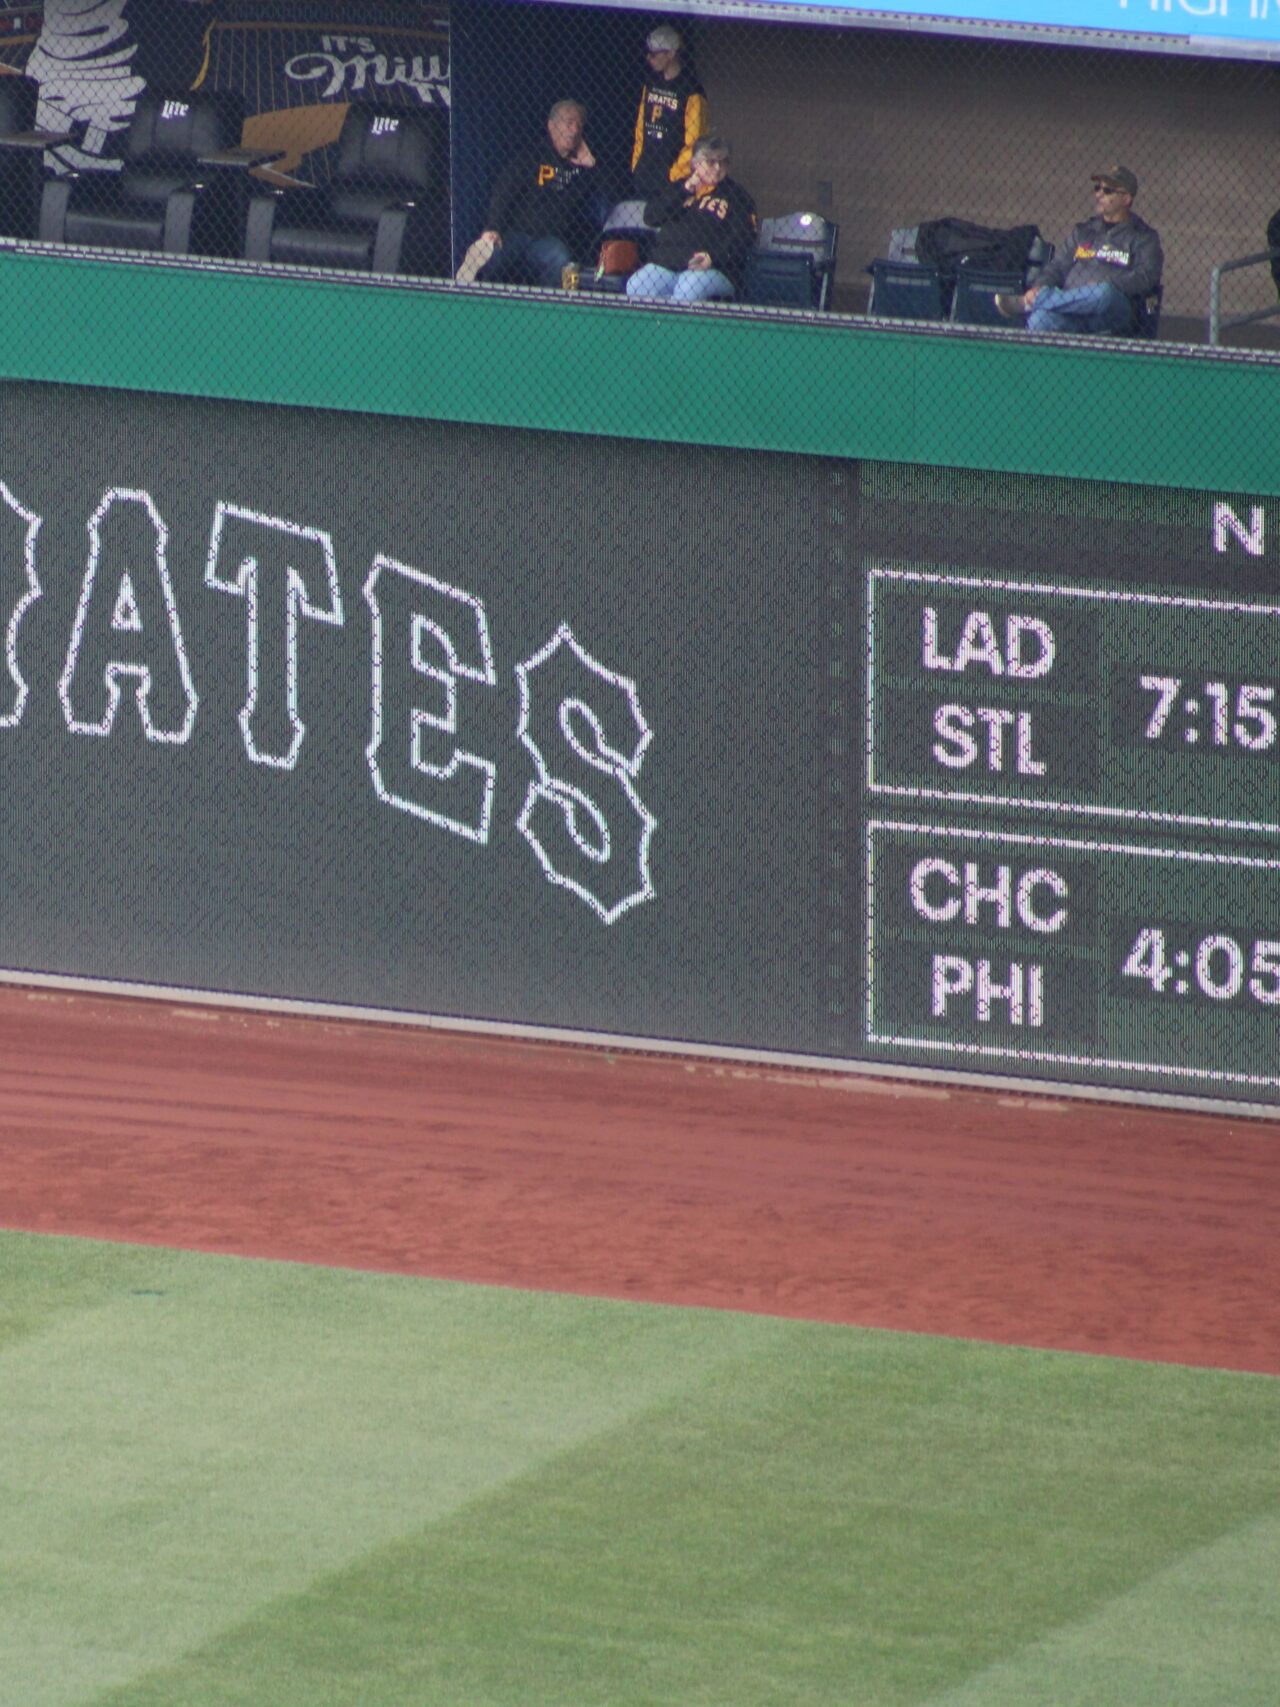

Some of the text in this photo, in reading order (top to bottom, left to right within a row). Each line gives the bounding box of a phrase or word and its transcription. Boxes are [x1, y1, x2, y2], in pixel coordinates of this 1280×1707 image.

[321, 35, 376, 51] IT'S
[161, 100, 189, 119] Lite
[371, 115, 399, 134] Lite
[538, 164, 555, 187] P
[923, 606, 1056, 679] LAD
[932, 703, 1047, 776] STL
[1140, 675, 1277, 750] 7:15
[910, 857, 1069, 934] CHC
[932, 954, 1044, 1028] PHI
[1122, 928, 1280, 1005] 4:05
